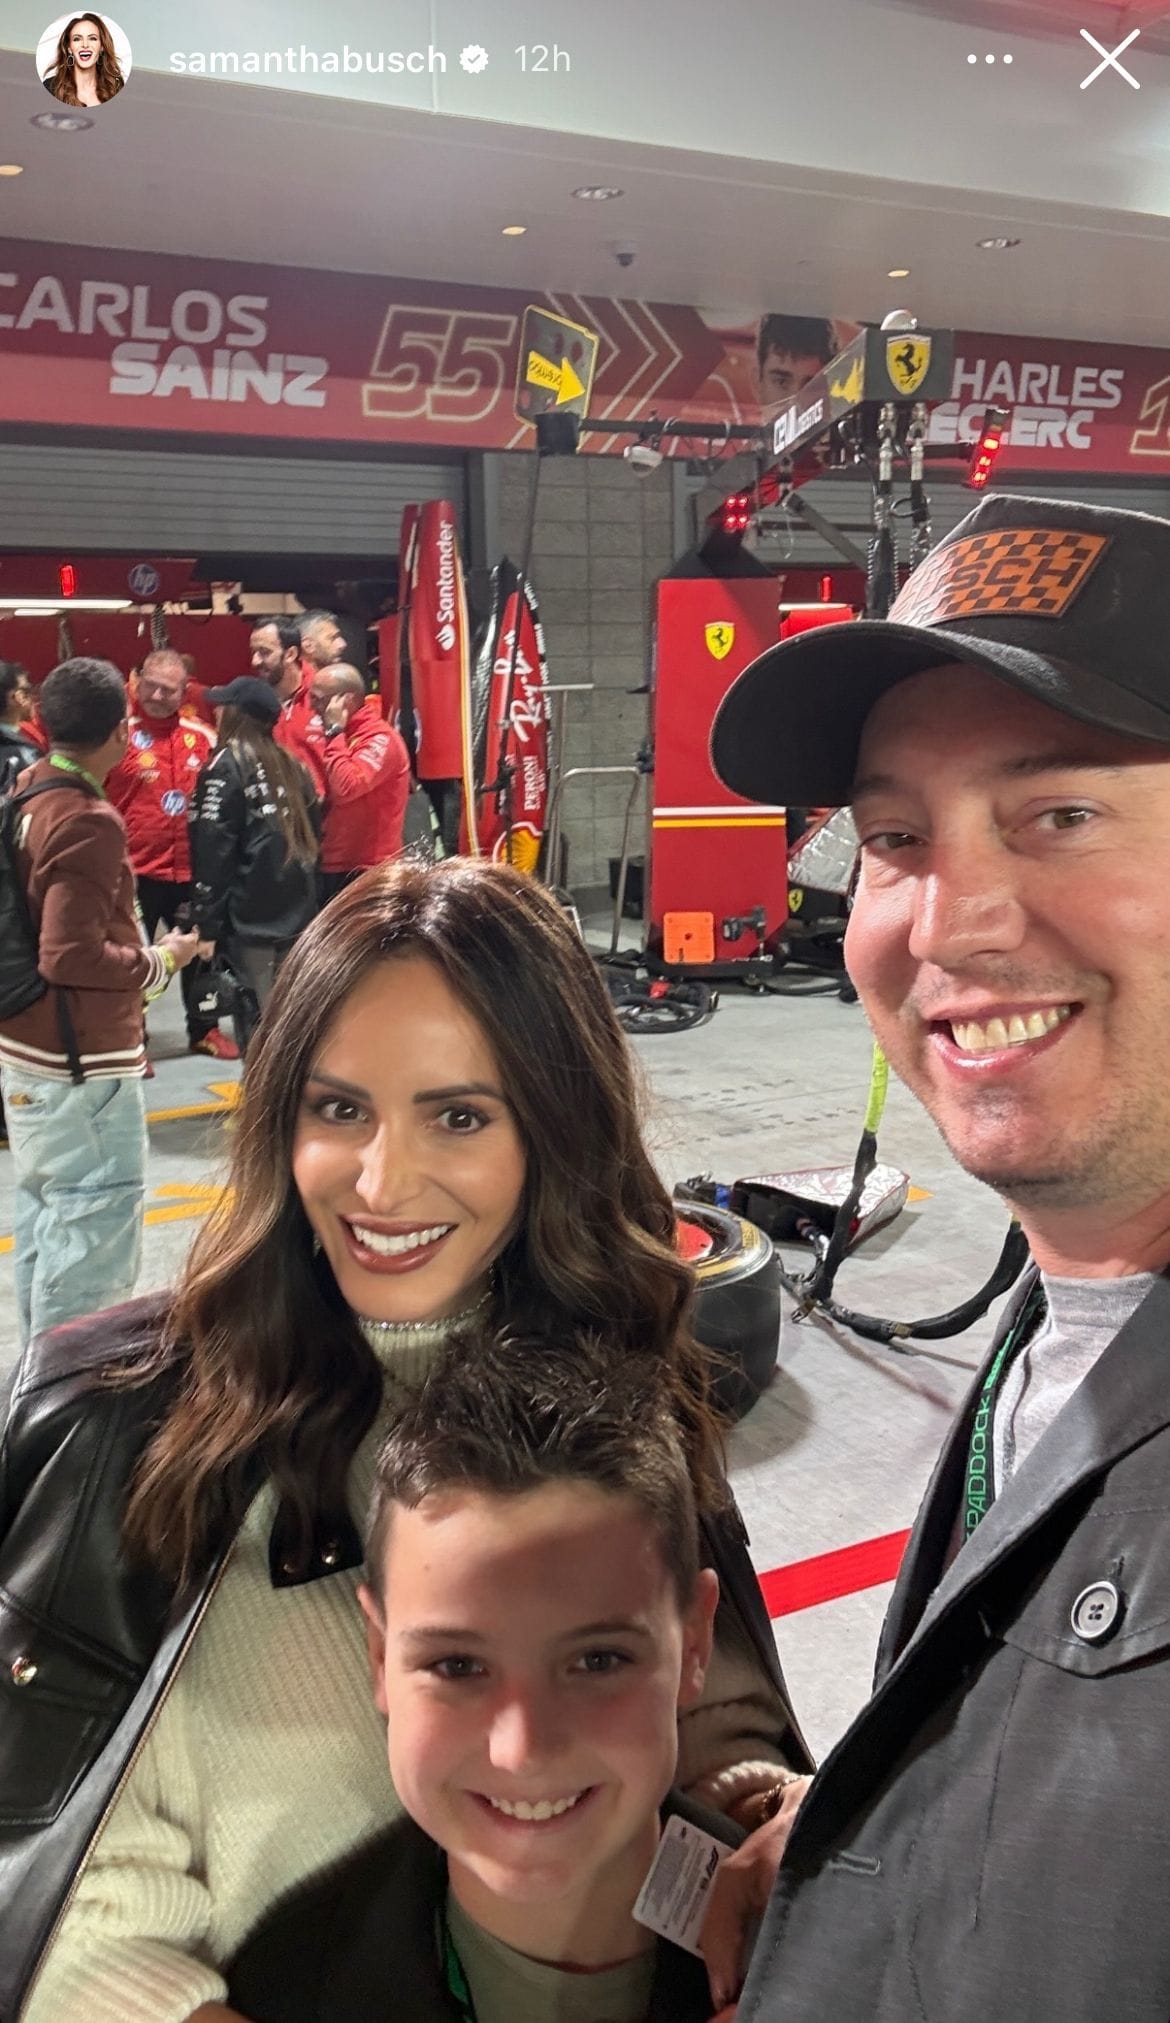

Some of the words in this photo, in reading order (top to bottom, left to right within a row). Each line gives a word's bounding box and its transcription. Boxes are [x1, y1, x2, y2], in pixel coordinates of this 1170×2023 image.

[109, 342, 329, 407] SAINZ
[362, 304, 517, 422] 55
[950, 357, 1124, 408] HARLES
[436, 520, 455, 623] Santander
[523, 756, 539, 811] PERONI
[966, 1395, 990, 1529] PADDOCK
